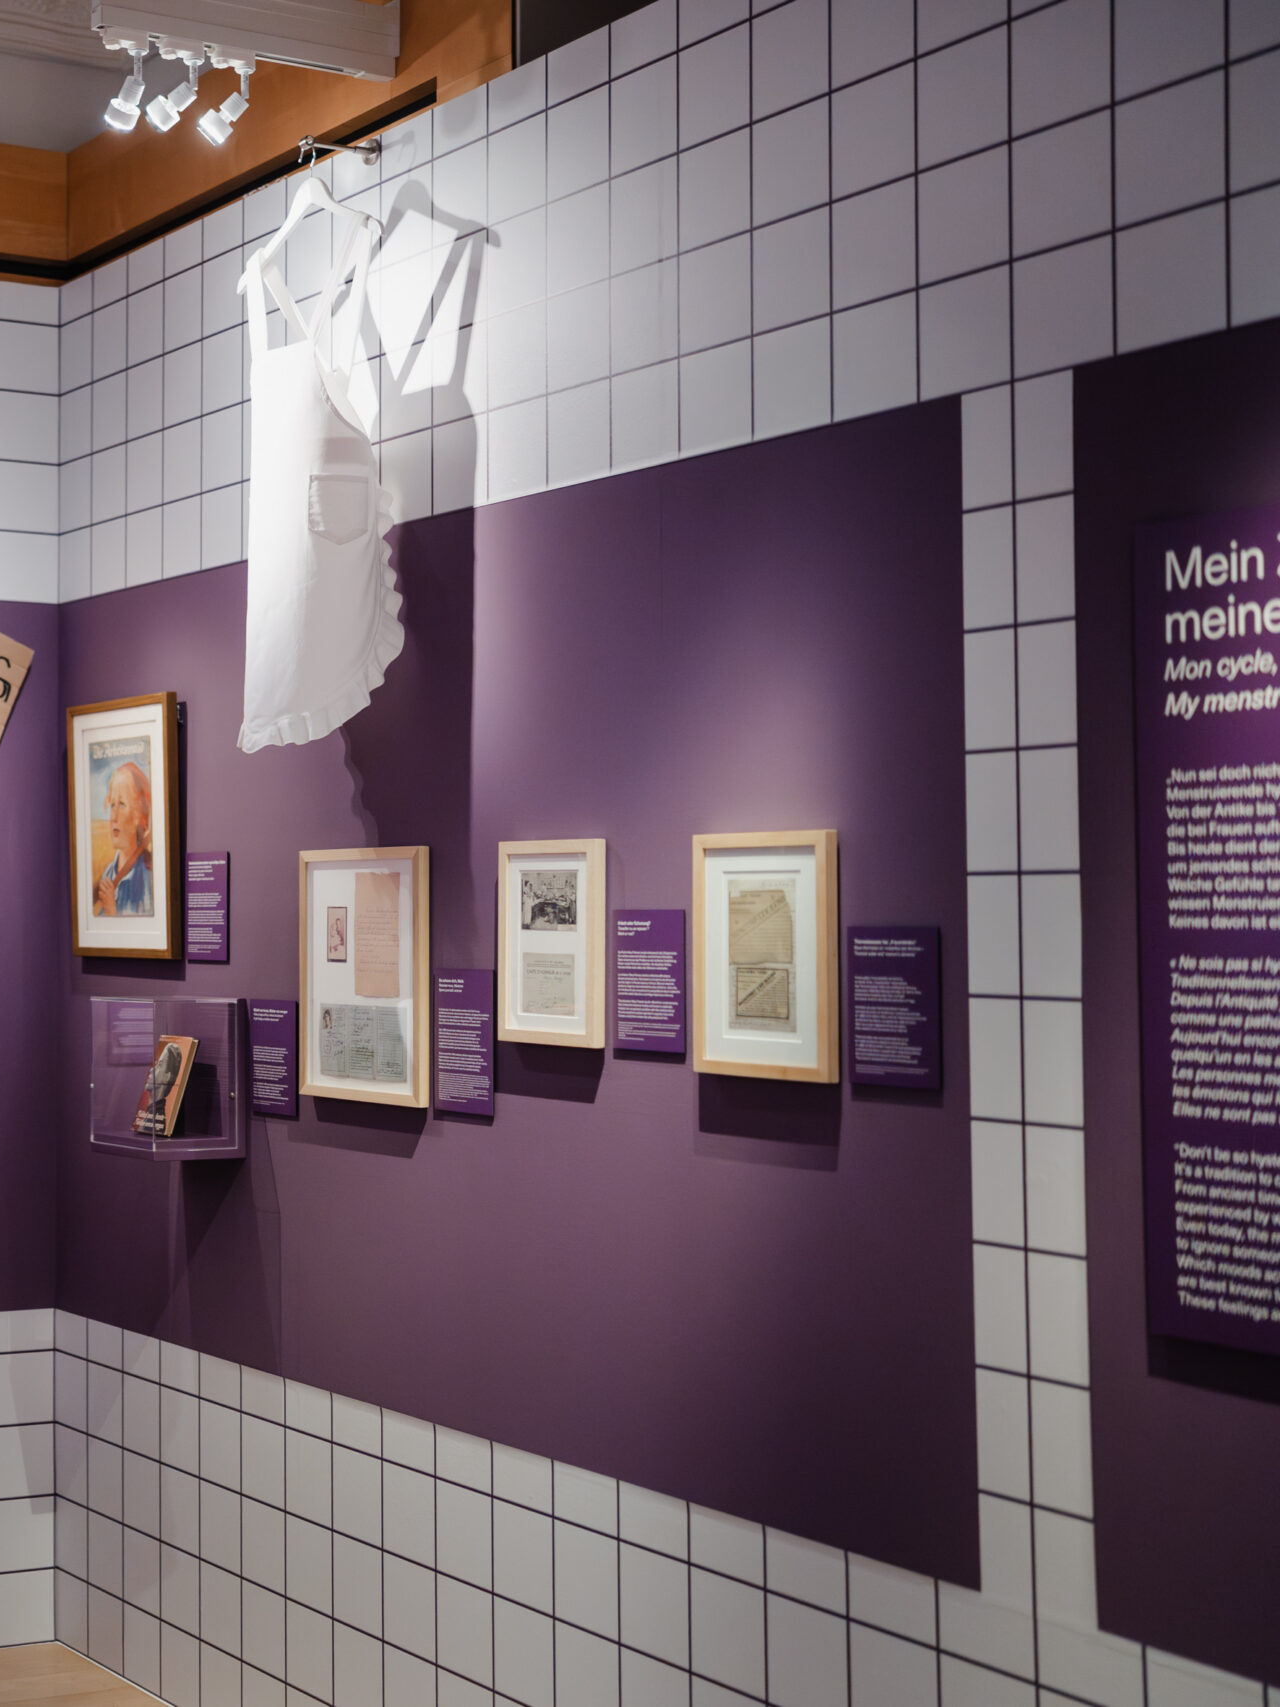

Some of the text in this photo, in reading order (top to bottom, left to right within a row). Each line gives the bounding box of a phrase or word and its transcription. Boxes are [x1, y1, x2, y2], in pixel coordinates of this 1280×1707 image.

[1165, 539, 1265, 592] Mein
[1164, 647, 1278, 682] Mon cycle,
[1164, 691, 1200, 720] My
